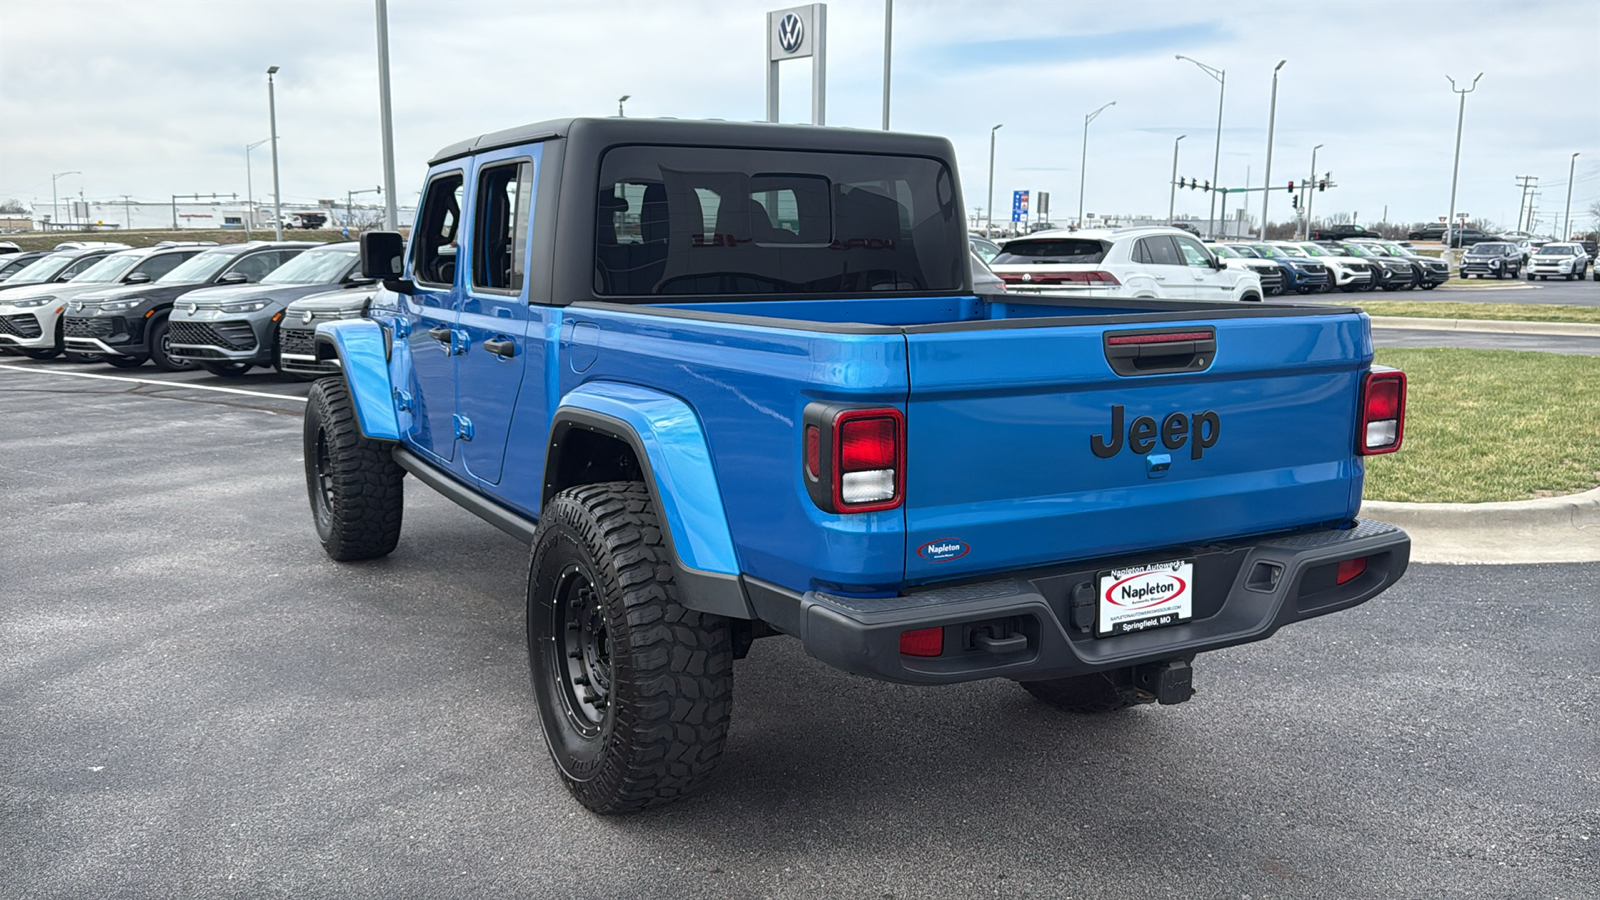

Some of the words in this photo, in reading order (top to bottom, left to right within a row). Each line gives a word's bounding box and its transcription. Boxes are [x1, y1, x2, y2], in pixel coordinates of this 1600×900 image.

[1090, 404, 1220, 460] Jeep
[928, 543, 960, 554] Napleton
[1111, 566, 1144, 577] Napleton
[1122, 582, 1174, 599] Napleton
[1122, 619, 1158, 631] Springfield,
[1160, 616, 1171, 625] MO
